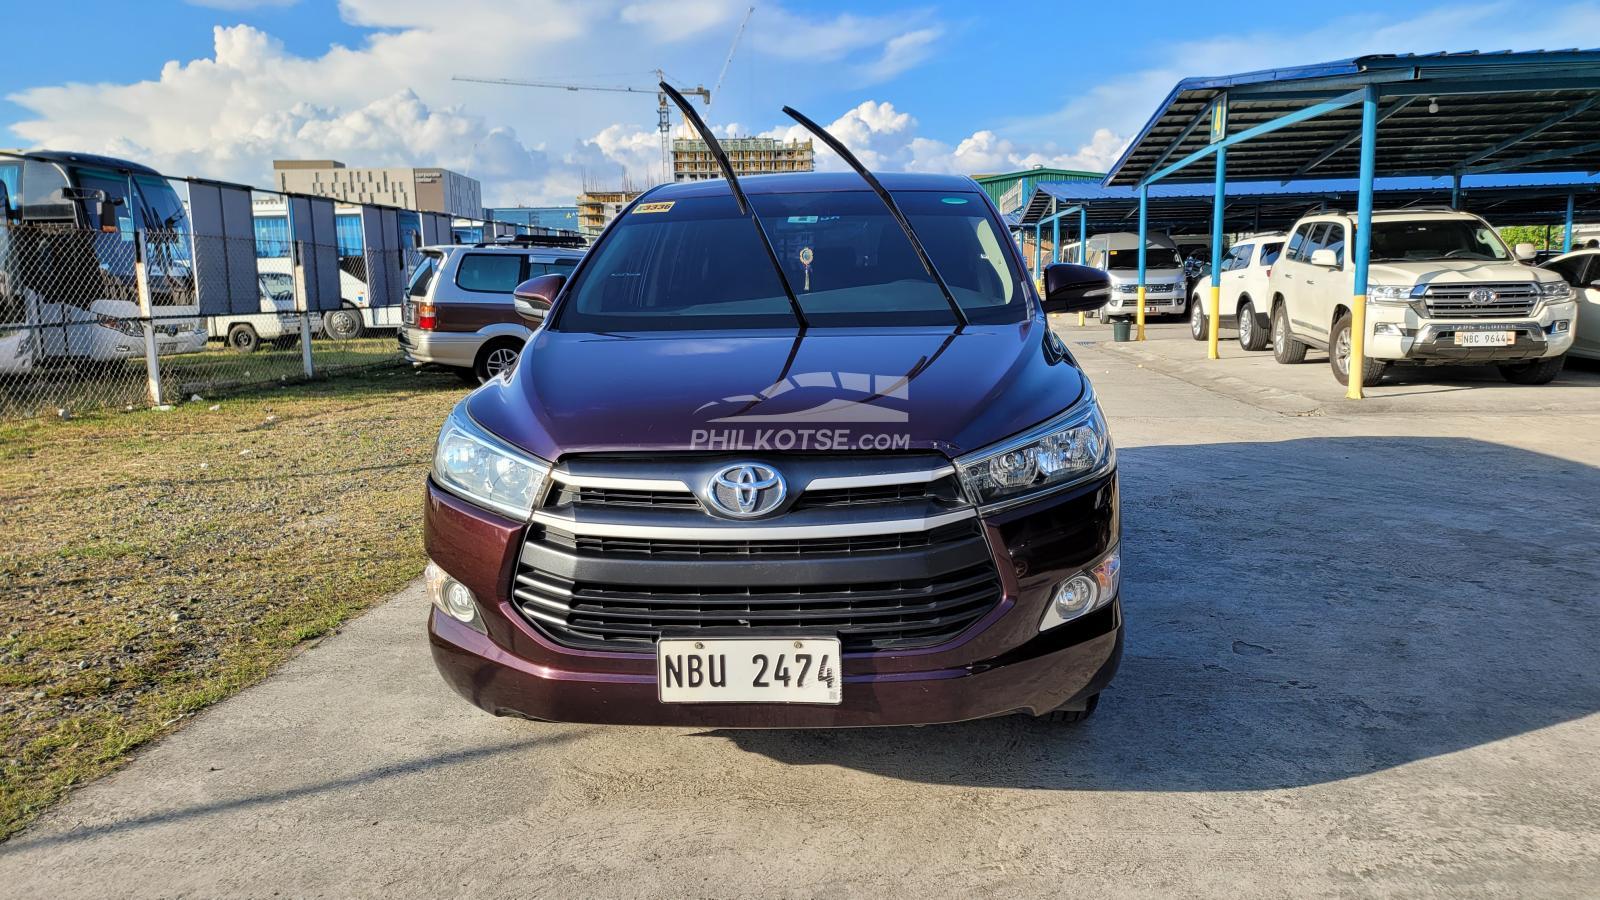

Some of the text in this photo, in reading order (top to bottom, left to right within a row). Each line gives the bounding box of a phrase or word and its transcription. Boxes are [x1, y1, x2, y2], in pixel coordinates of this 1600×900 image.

[1463, 334, 1479, 343] NBC
[1484, 334, 1506, 343] 9644
[665, 653, 834, 689] NBU 2474
